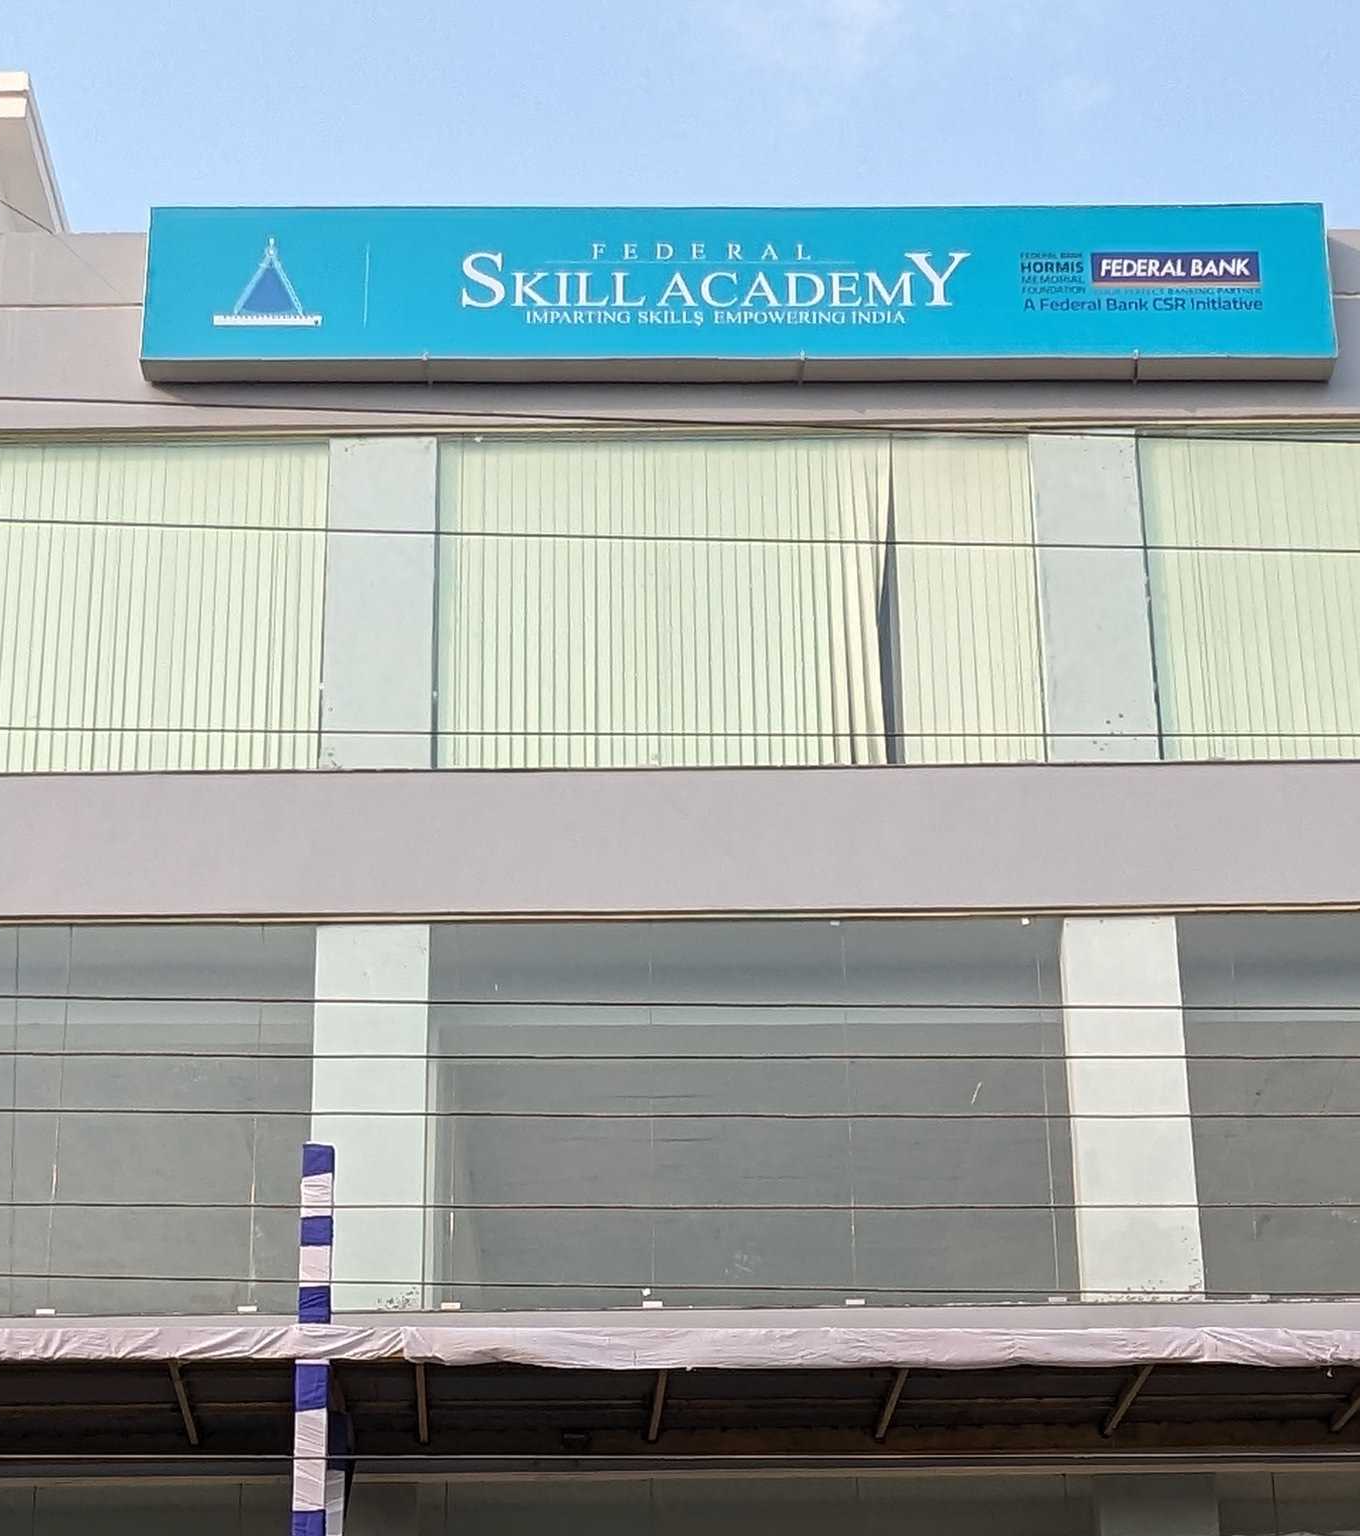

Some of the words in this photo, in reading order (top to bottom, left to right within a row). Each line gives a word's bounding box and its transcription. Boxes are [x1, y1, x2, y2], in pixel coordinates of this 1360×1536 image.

[592, 243, 812, 261] FEDERAL
[1020, 261, 1084, 273] HORMIS
[1100, 257, 1185, 278] FEDERAL
[1190, 257, 1251, 277] BANK
[461, 252, 646, 309] SKILL
[658, 251, 971, 308] ACADEMY
[1021, 275, 1085, 284] MEMORIAL
[1021, 286, 1086, 294] FOUNDATION
[1023, 299, 1035, 312] A
[1040, 298, 1101, 312] Federal
[1106, 298, 1148, 312] Bank
[1152, 298, 1187, 312] CSR
[1191, 298, 1264, 312] Initiative
[525, 311, 631, 325] IMPARTING
[638, 311, 704, 327] SKILLS
[714, 311, 846, 325] EMPOWERING
[851, 311, 906, 325] INDIA
